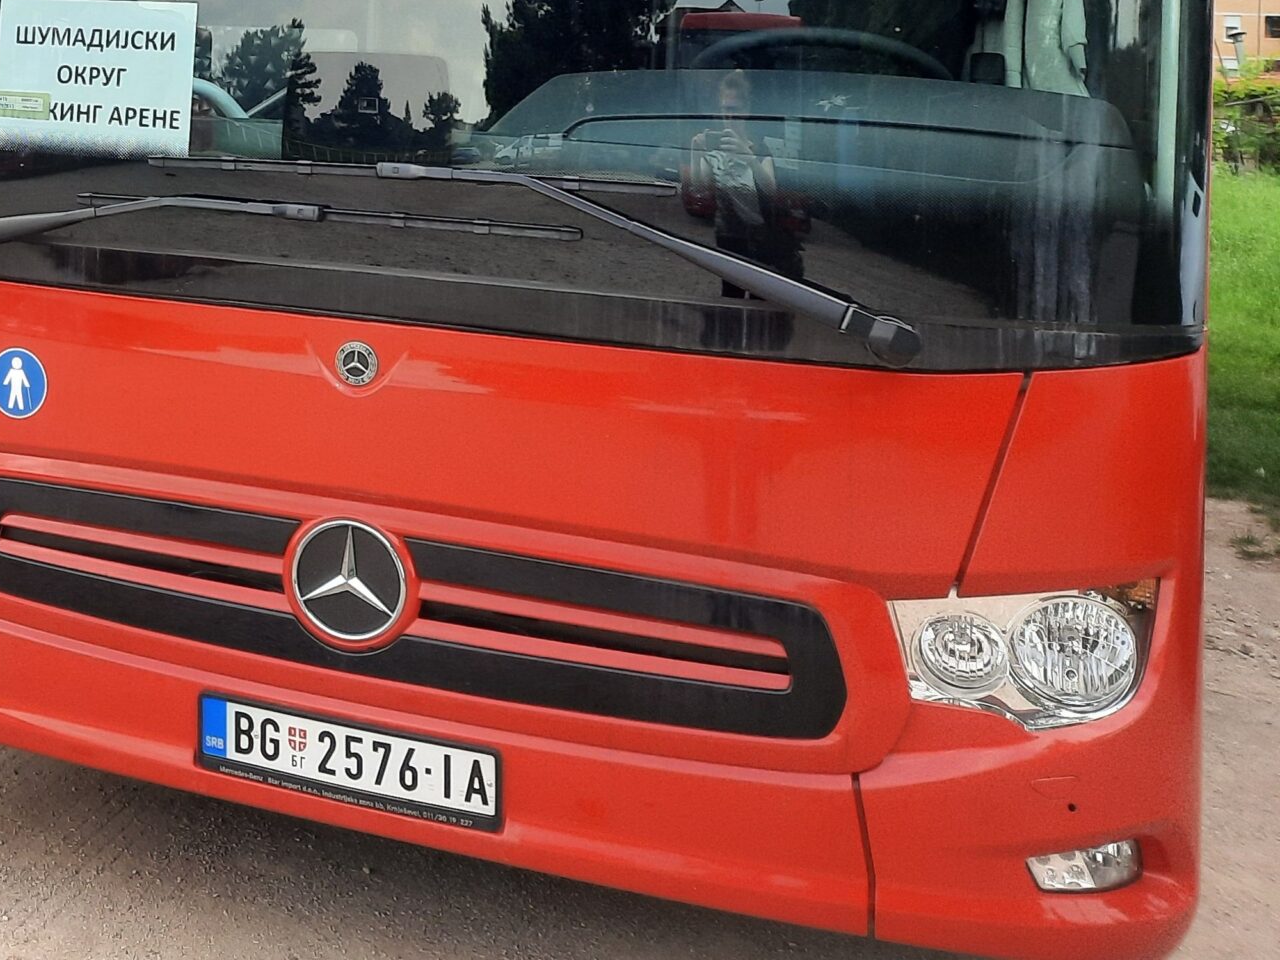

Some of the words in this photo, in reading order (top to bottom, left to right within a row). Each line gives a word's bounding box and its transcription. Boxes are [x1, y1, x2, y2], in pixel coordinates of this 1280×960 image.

[16, 25, 176, 52] ШУМАДИЈСКИ
[57, 64, 127, 87] ОКРУГ
[49, 102, 103, 124] КИНГ
[108, 106, 181, 130] АРЕНЕ
[205, 735, 225, 750] SRB
[234, 710, 281, 761] BG
